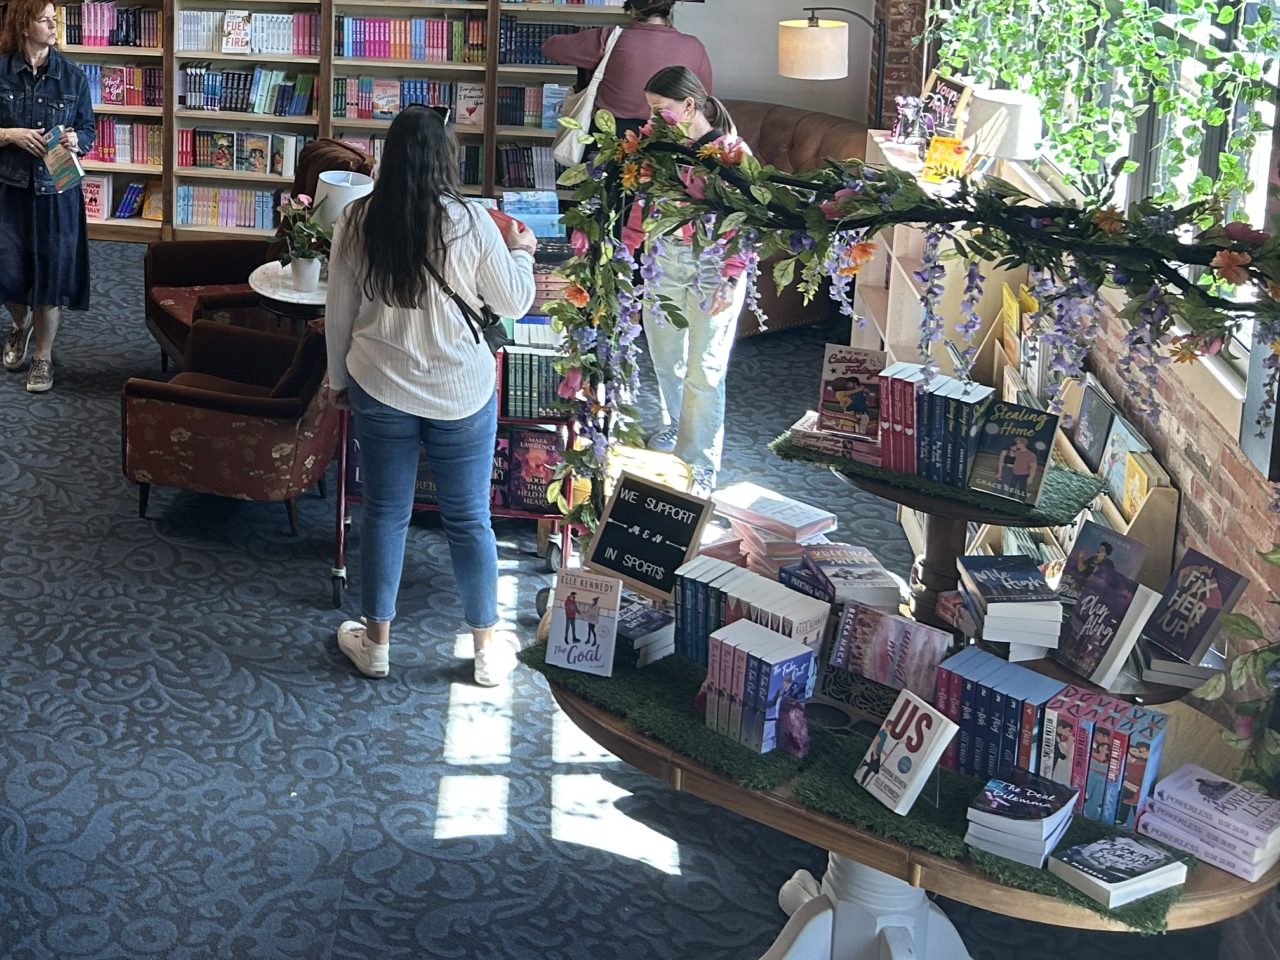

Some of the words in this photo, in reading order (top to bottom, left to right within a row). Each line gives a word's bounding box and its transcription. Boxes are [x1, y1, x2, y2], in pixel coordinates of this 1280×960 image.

[226, 21, 247, 31] FUEL
[225, 37, 246, 47] FIRE
[102, 77, 120, 88] Hard
[111, 84, 123, 100] Get
[828, 353, 868, 367] Catching
[990, 403, 1050, 431] Stealing
[1000, 421, 1036, 437] Home
[520, 442, 556, 451] LAWRENCE
[526, 477, 547, 485] BOOK
[527, 484, 547, 493] THAT
[976, 478, 1002, 490] GRACE
[1003, 484, 1032, 498] REILLY
[517, 490, 538, 499] HELD
[620, 488, 638, 505] WE
[644, 496, 696, 525] SUPPORT
[604, 547, 618, 561] IN
[560, 575, 579, 587] ELLE
[580, 577, 614, 593] KENNEDY
[974, 568, 1010, 583] Mile
[1001, 576, 1045, 590] High
[1080, 595, 1111, 617] Play
[1168, 589, 1207, 624] HER
[843, 607, 856, 636] BECKA
[1078, 615, 1114, 646] Along
[1162, 614, 1189, 640] UP
[553, 645, 568, 655] The
[566, 644, 602, 665] Goal
[838, 638, 848, 664] MACK
[889, 698, 933, 754] US
[1046, 718, 1054, 737] HELENA
[1042, 737, 1052, 759] HUNTING
[1111, 739, 1121, 759] HELENA
[1108, 758, 1118, 781] HUNTING
[992, 788, 1052, 809] Dilemma
[995, 780, 1019, 793] The
[1026, 788, 1056, 801] Deal
[1166, 796, 1213, 821] POWERLESS
[1157, 807, 1202, 834] POWERLESS
[1151, 826, 1199, 853] POWERLESS
[1071, 861, 1109, 881] MASSERY
